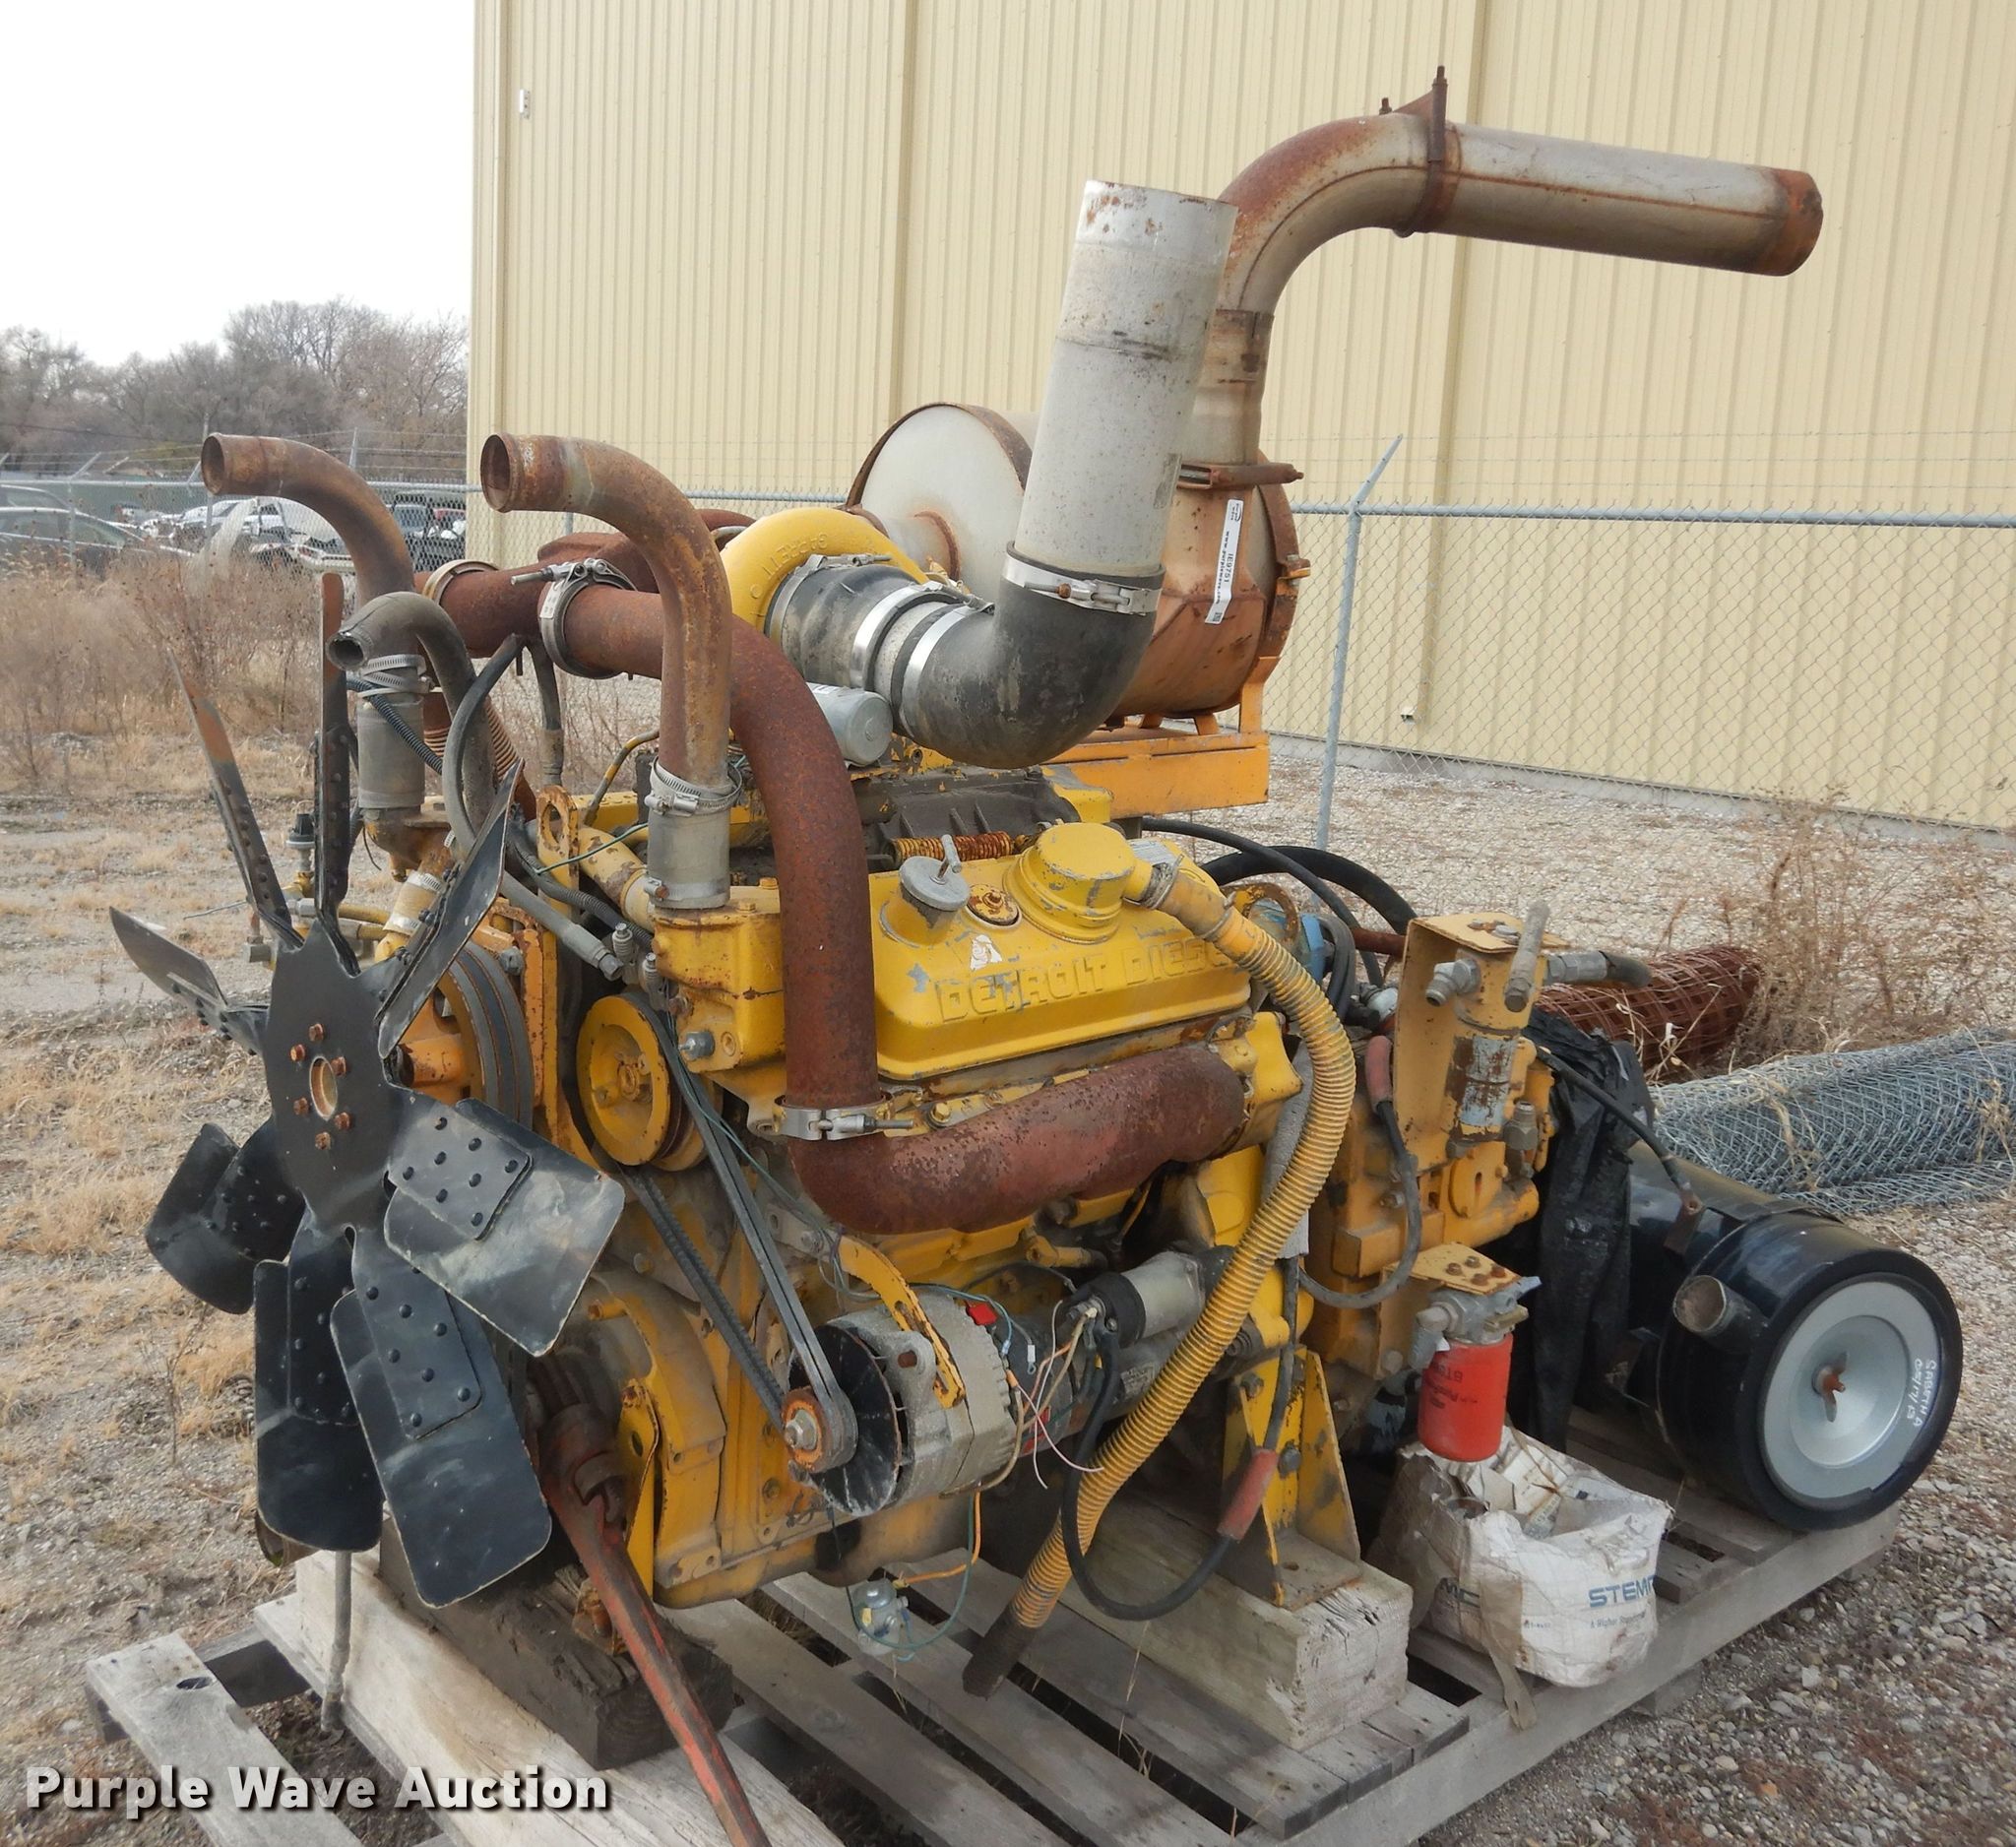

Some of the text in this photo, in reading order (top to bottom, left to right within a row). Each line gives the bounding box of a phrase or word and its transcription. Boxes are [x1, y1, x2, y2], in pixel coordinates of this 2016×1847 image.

[1224, 553, 1234, 583] IE9751
[936, 937, 1236, 1023] DETROIT DIESE
